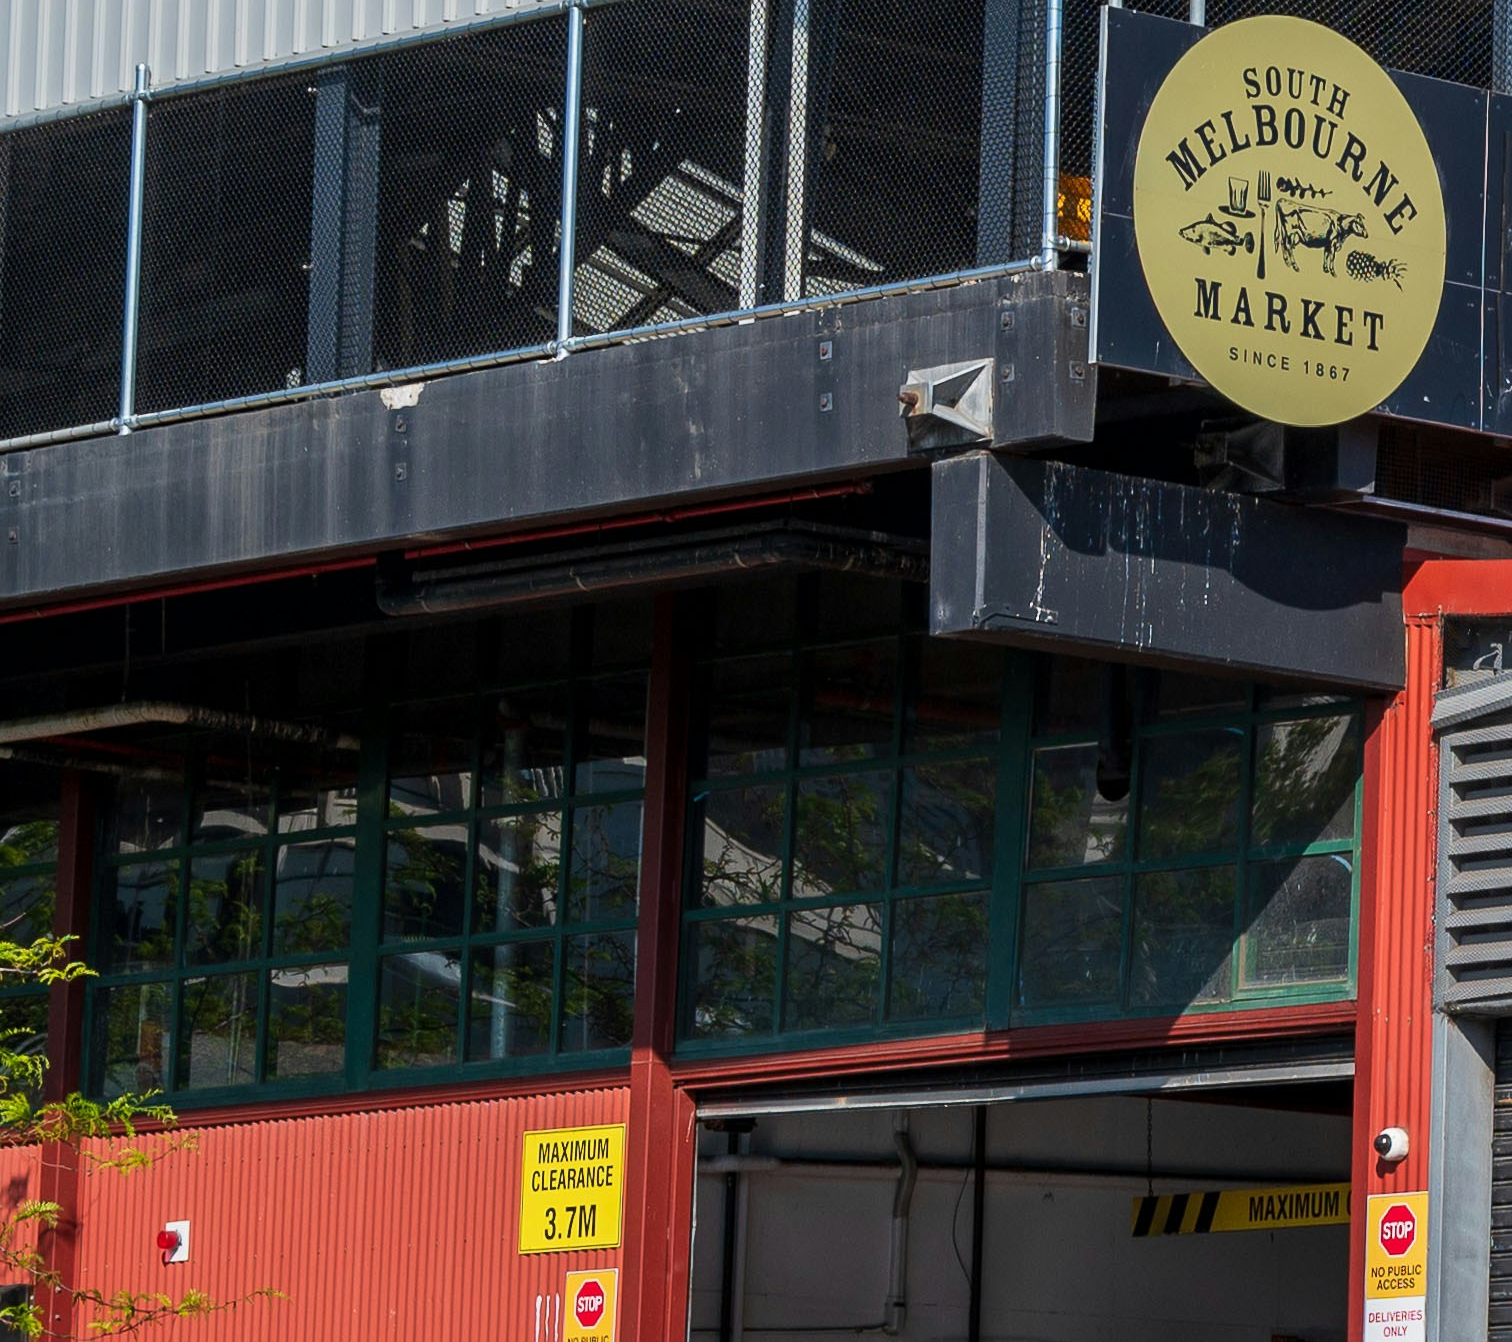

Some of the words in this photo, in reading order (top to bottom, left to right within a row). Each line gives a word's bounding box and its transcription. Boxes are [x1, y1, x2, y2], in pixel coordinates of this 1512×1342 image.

[1243, 66, 1350, 120] SOUTH
[1165, 104, 1418, 236] MELBOURNE
[1194, 278, 1384, 352] MARKET
[1229, 346, 1290, 371] SINCE
[1303, 359, 1351, 383] 1867
[538, 1138, 609, 1164] MAXIMUM
[532, 1166, 614, 1192] CLEARANCE
[1249, 1190, 1340, 1222] MAXIMUM
[545, 1204, 597, 1240] 3.7M
[1383, 1221, 1413, 1240] STOP
[1371, 1266, 1385, 1278] NO
[1388, 1264, 1422, 1277] PUBLIC
[1376, 1278, 1415, 1290] ACCESS
[578, 1295, 603, 1313] STOP
[1368, 1310, 1423, 1323] DELIVERIES
[1383, 1325, 1408, 1337] ONLY
